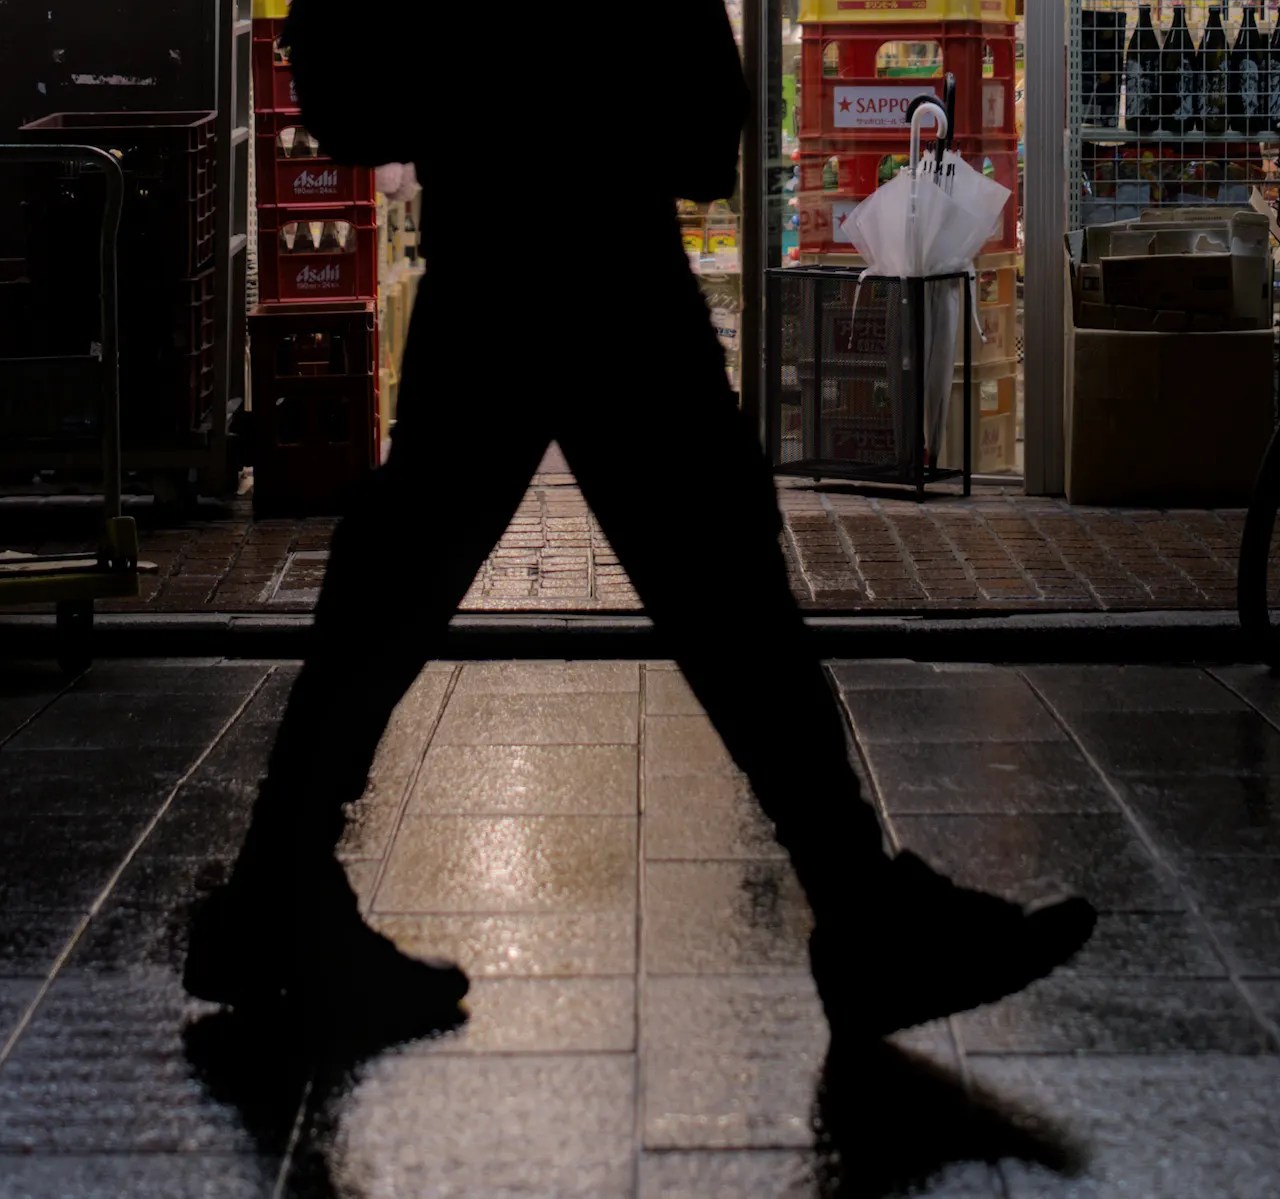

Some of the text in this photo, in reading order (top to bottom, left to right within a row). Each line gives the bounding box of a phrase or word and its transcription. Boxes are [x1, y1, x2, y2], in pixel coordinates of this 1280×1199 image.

[856, 97, 909, 113] SAPPO
[293, 169, 338, 188] Asahi
[296, 263, 340, 283] Asahi
